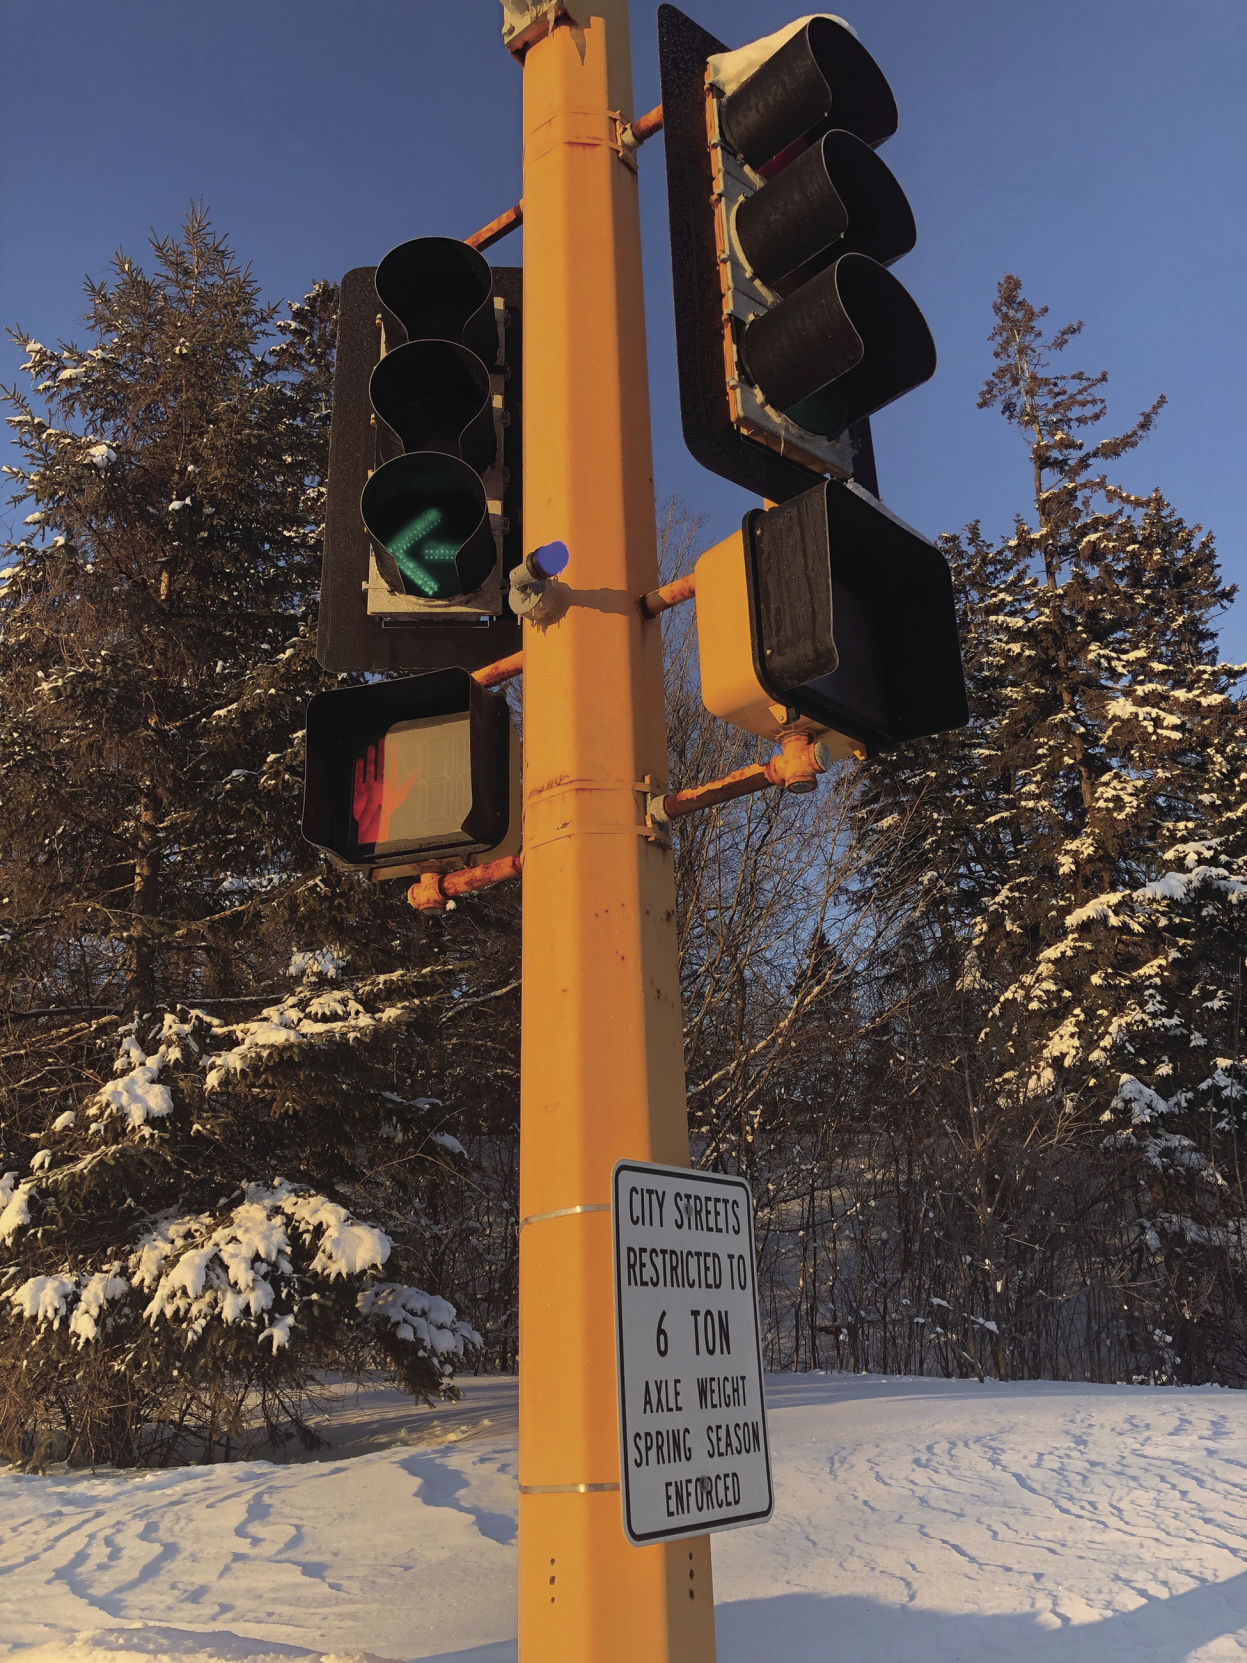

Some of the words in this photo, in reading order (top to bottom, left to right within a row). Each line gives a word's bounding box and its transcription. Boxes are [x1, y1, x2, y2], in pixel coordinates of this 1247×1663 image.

[629, 1186, 666, 1228] CITY
[674, 1192, 741, 1235] STREETS
[626, 1246, 722, 1290] RESTRICTED
[727, 1253, 747, 1291] TO
[656, 1309, 669, 1357] 6
[690, 1309, 731, 1356] TON
[643, 1379, 683, 1414] AXLE
[697, 1375, 747, 1410] WEIGHT
[633, 1428, 692, 1468] SPRING
[706, 1421, 761, 1459] SEASON
[665, 1472, 741, 1517] ENFORCED
